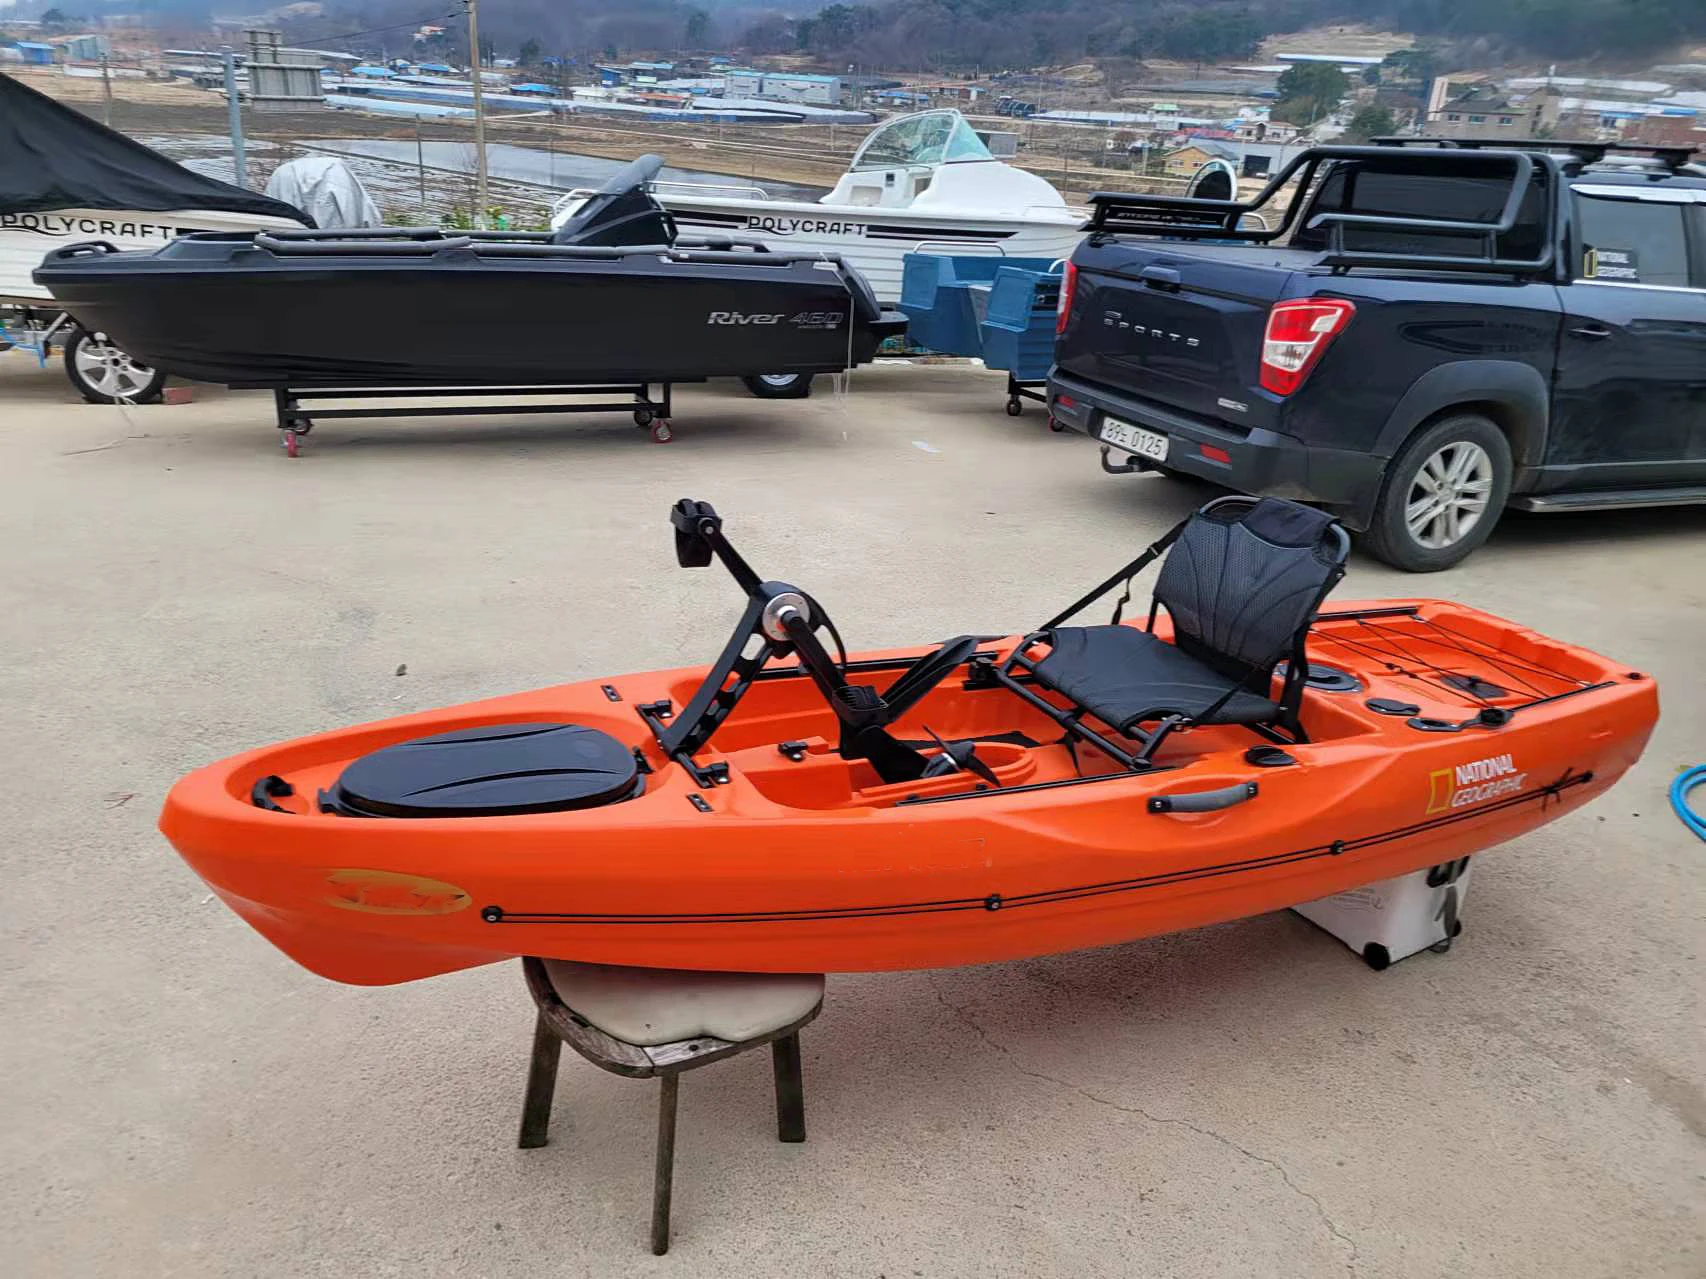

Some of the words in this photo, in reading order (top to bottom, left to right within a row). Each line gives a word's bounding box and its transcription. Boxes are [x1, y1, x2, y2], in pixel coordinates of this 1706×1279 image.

[1, 214, 173, 239] POLYCRAFT
[748, 216, 865, 235] POLYCRAFT
[707, 311, 785, 325] River
[788, 311, 844, 324] 460
[1103, 318, 1200, 346] SPORTS
[1131, 431, 1163, 456] 0125
[1455, 753, 1517, 787] NATIONAL
